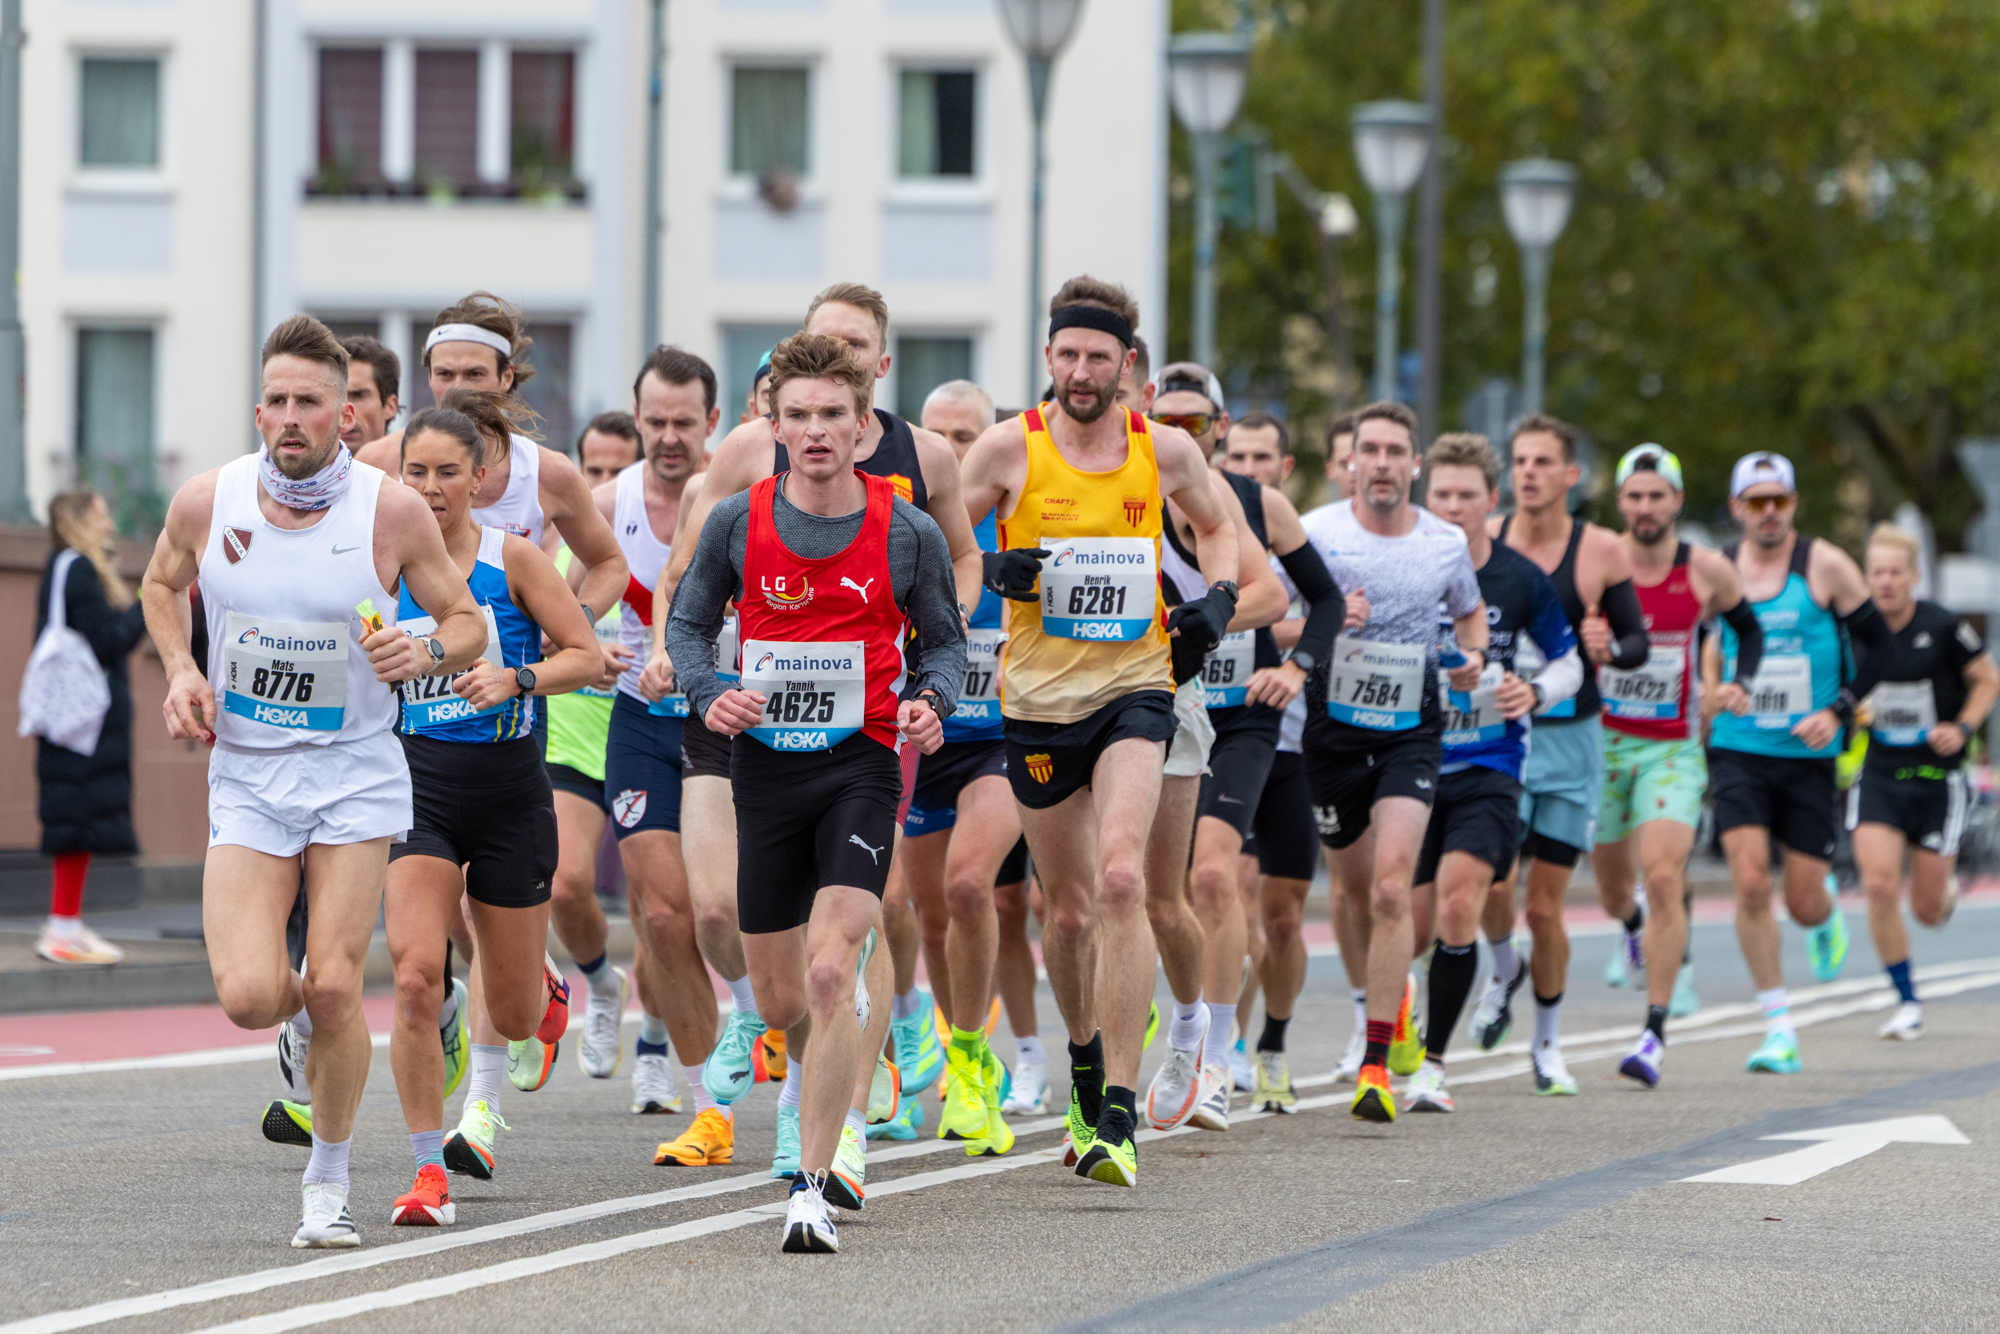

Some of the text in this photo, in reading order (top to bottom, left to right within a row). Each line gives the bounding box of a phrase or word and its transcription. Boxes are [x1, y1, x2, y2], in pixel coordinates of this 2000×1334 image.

[1075, 551, 1145, 565] mainova
[1084, 575, 1111, 585] Henrik
[765, 587, 814, 611] Region Karlsruhe
[1068, 586, 1127, 615] 6281
[1072, 622, 1123, 638] HOKA
[260, 635, 336, 651] mainova
[271, 659, 294, 672] Mats
[775, 656, 852, 671] mainova
[1364, 654, 1419, 668] mainova
[252, 667, 315, 703] 8776
[786, 680, 817, 692] Yannik
[963, 671, 992, 697] 07
[1204, 691, 1226, 705] KA
[1351, 679, 1403, 708] 7584
[254, 704, 309, 727] HOKA
[428, 701, 478, 723] HOKA
[766, 692, 836, 723] 4625
[951, 703, 988, 718] OKA
[1352, 710, 1395, 728] HOKA
[774, 732, 829, 748] HOKA
